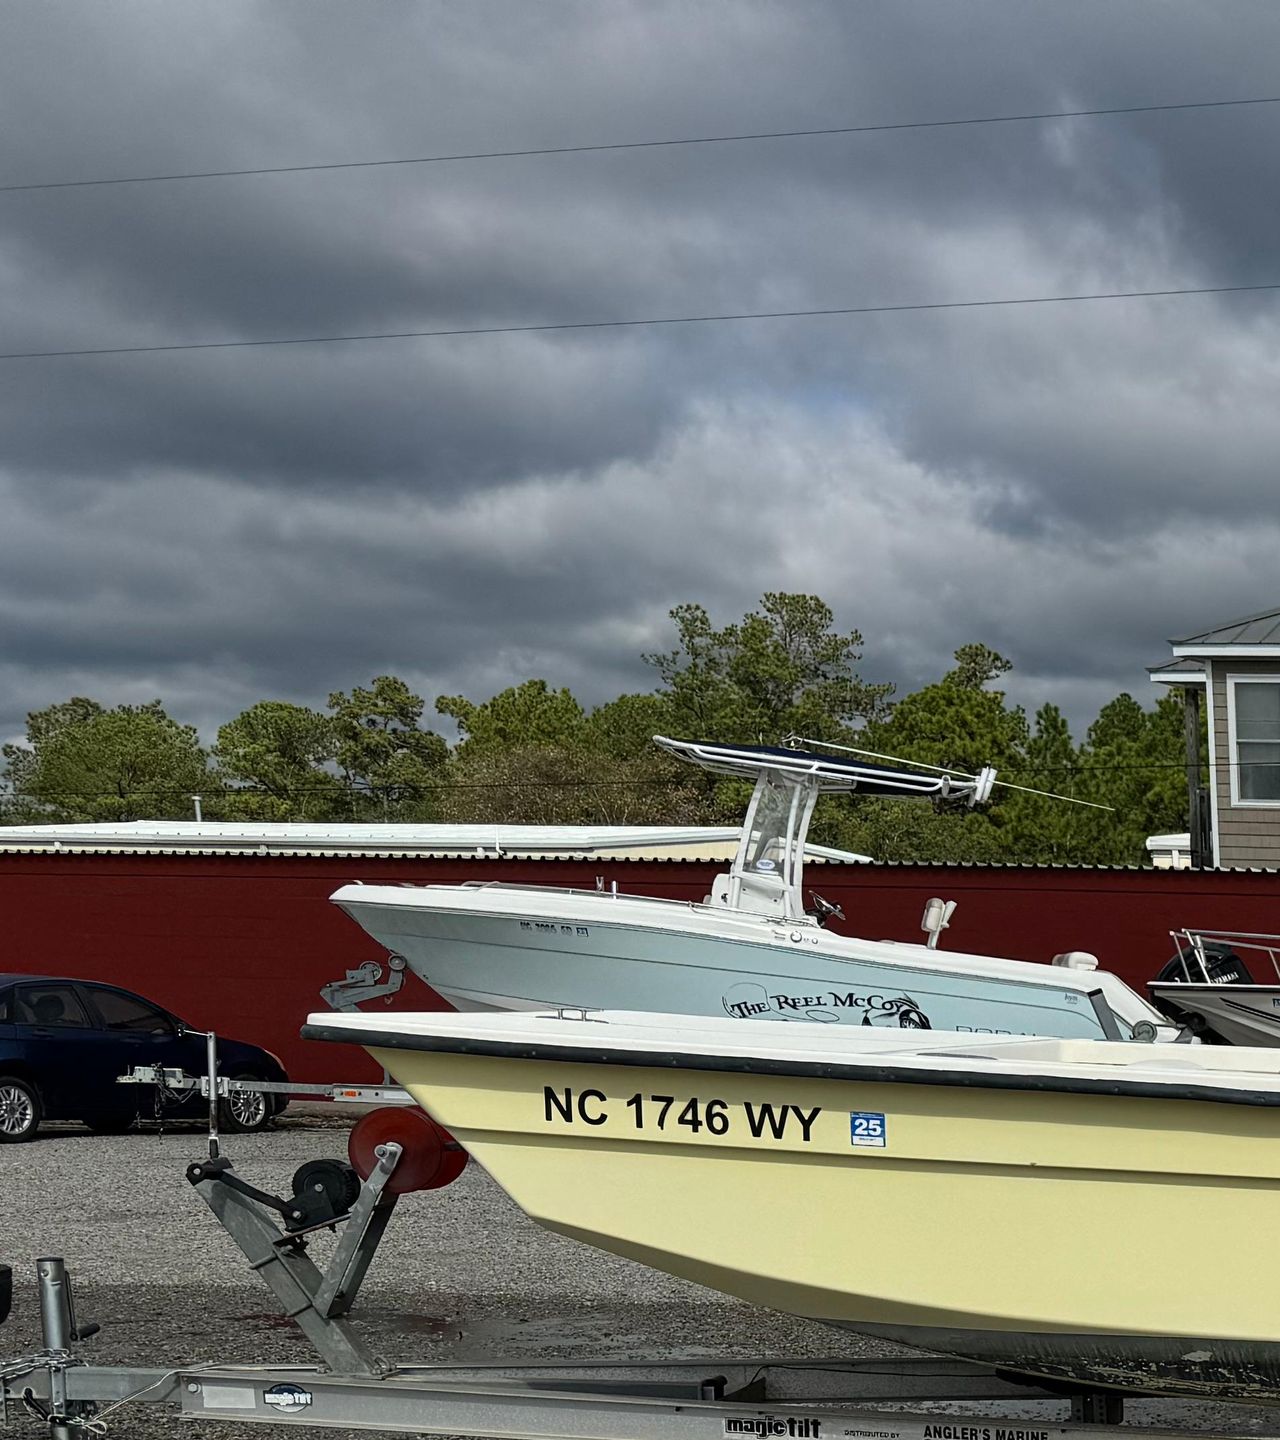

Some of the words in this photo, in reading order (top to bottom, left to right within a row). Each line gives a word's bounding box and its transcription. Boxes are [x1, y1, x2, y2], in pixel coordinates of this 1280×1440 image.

[543, 1085, 608, 1126] NC
[626, 1093, 730, 1135] 1746
[743, 1101, 823, 1142] WY
[854, 1118, 882, 1136] 25
[844, 1429, 889, 1439] DISTRIBUTED
